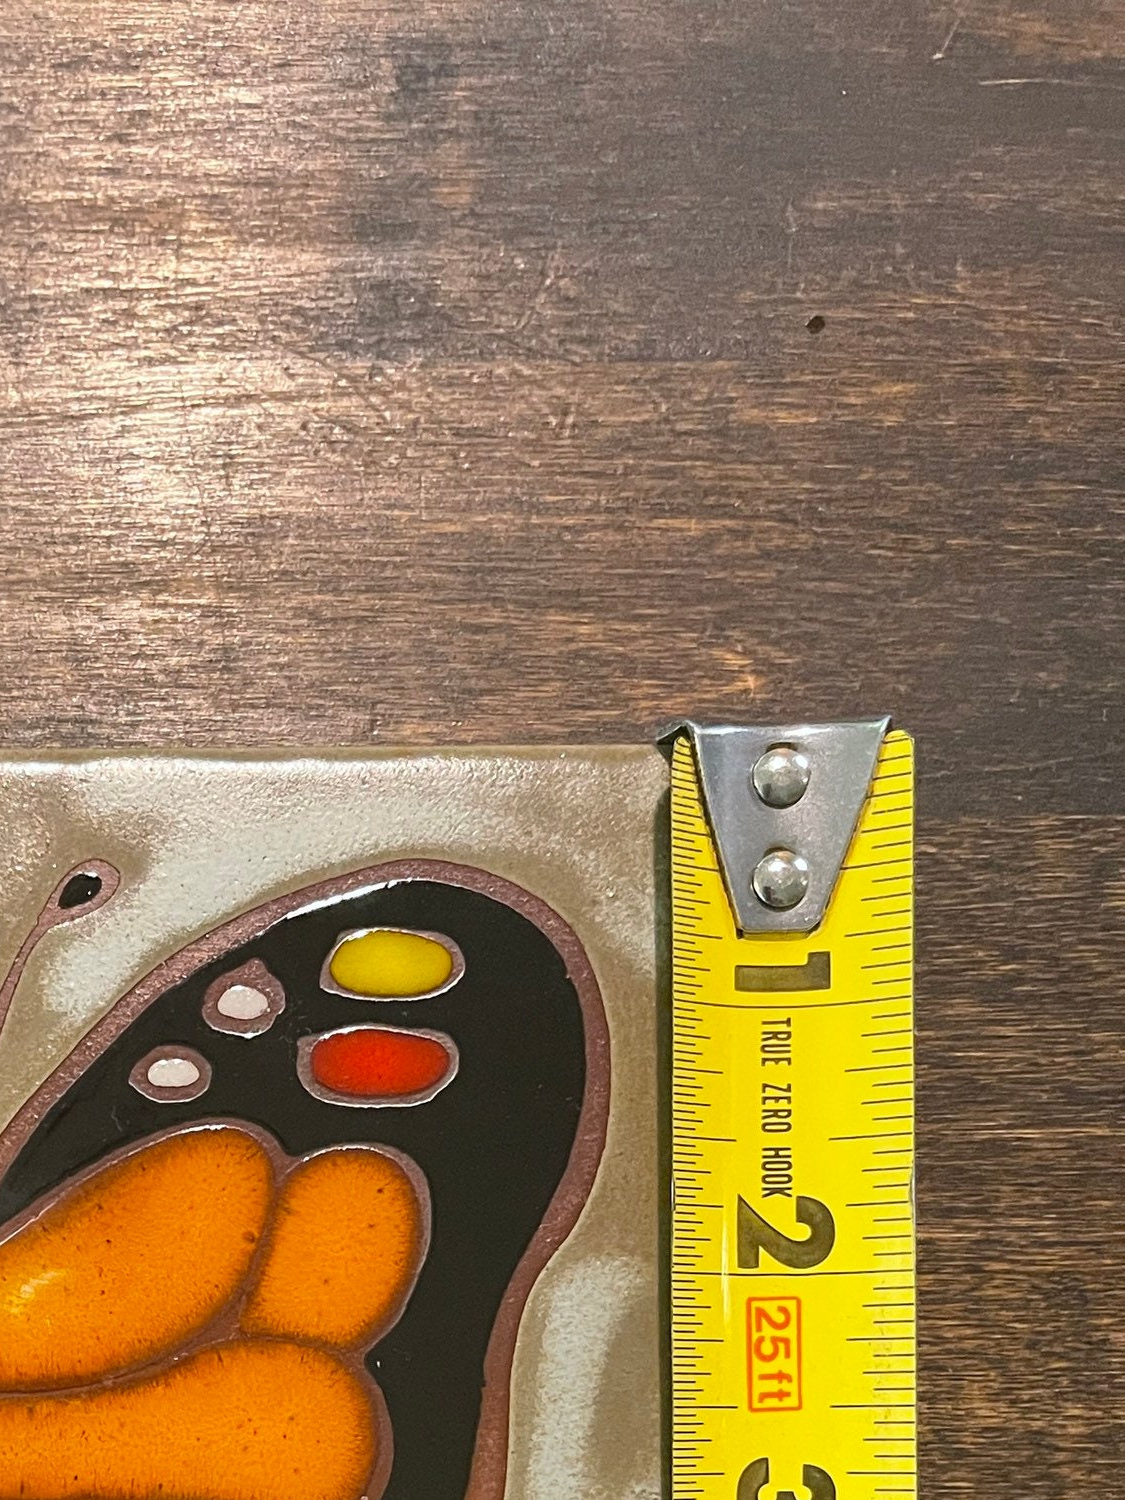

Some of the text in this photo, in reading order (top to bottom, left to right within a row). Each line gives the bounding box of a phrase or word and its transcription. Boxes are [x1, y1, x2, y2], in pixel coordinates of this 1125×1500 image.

[735, 951, 830, 992] 1
[760, 1017, 793, 1198] TRUE ZERO HOOK
[737, 1194, 835, 1269] 2
